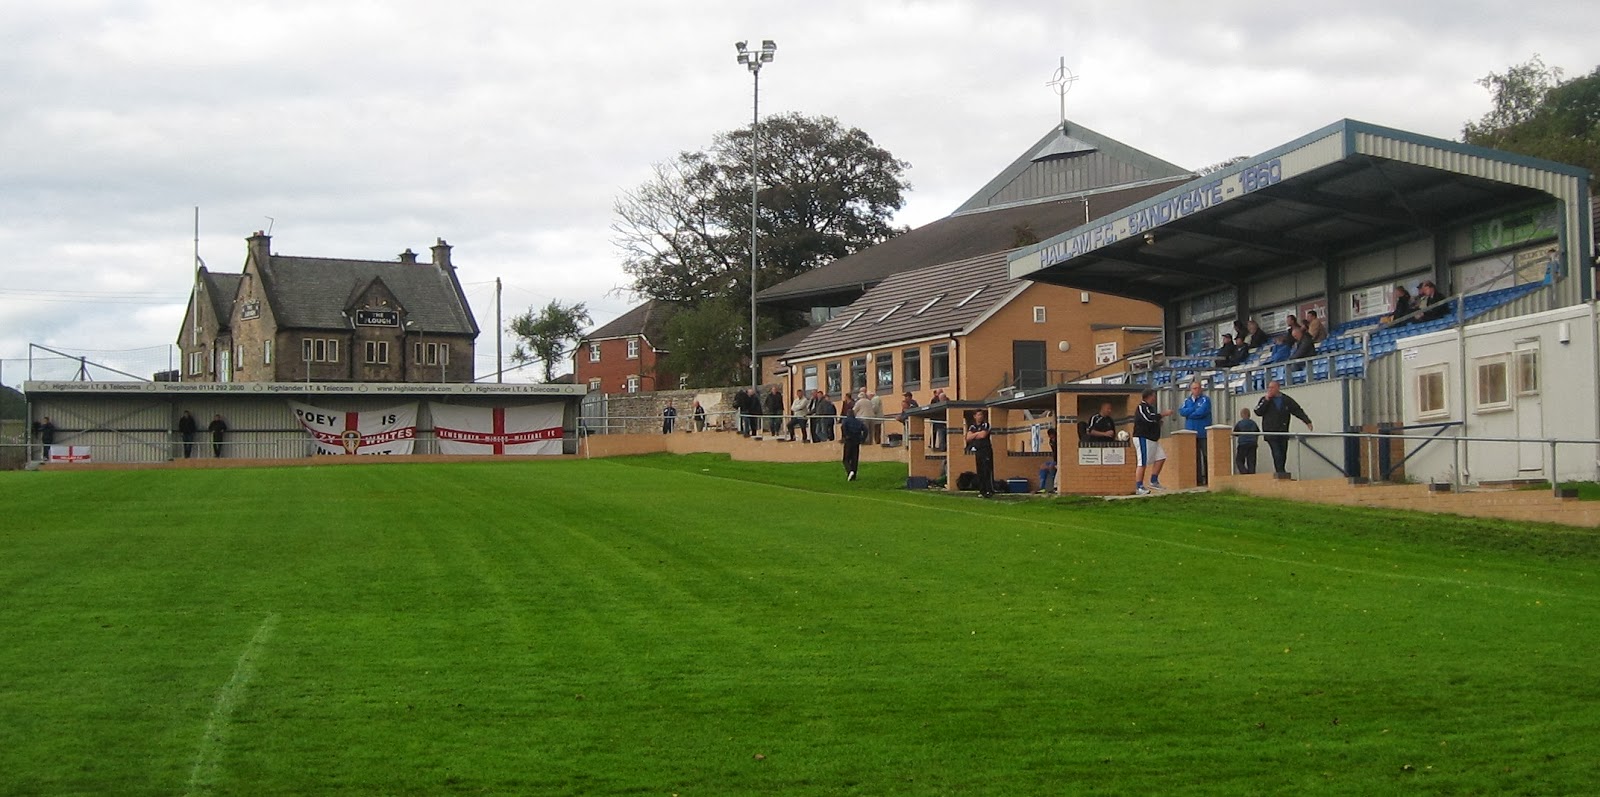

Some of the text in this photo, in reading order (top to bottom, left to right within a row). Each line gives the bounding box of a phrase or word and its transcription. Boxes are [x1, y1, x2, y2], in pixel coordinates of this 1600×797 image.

[1040, 231, 1092, 268] HALLAM
[1093, 222, 1118, 247] F.C.
[1128, 179, 1223, 236] SANDYGATE
[1239, 159, 1282, 193] 1860
[52, 383, 89, 391] Highlander
[163, 384, 197, 392] Telephone
[382, 414, 396, 425] IS
[365, 428, 413, 445] WHITES
